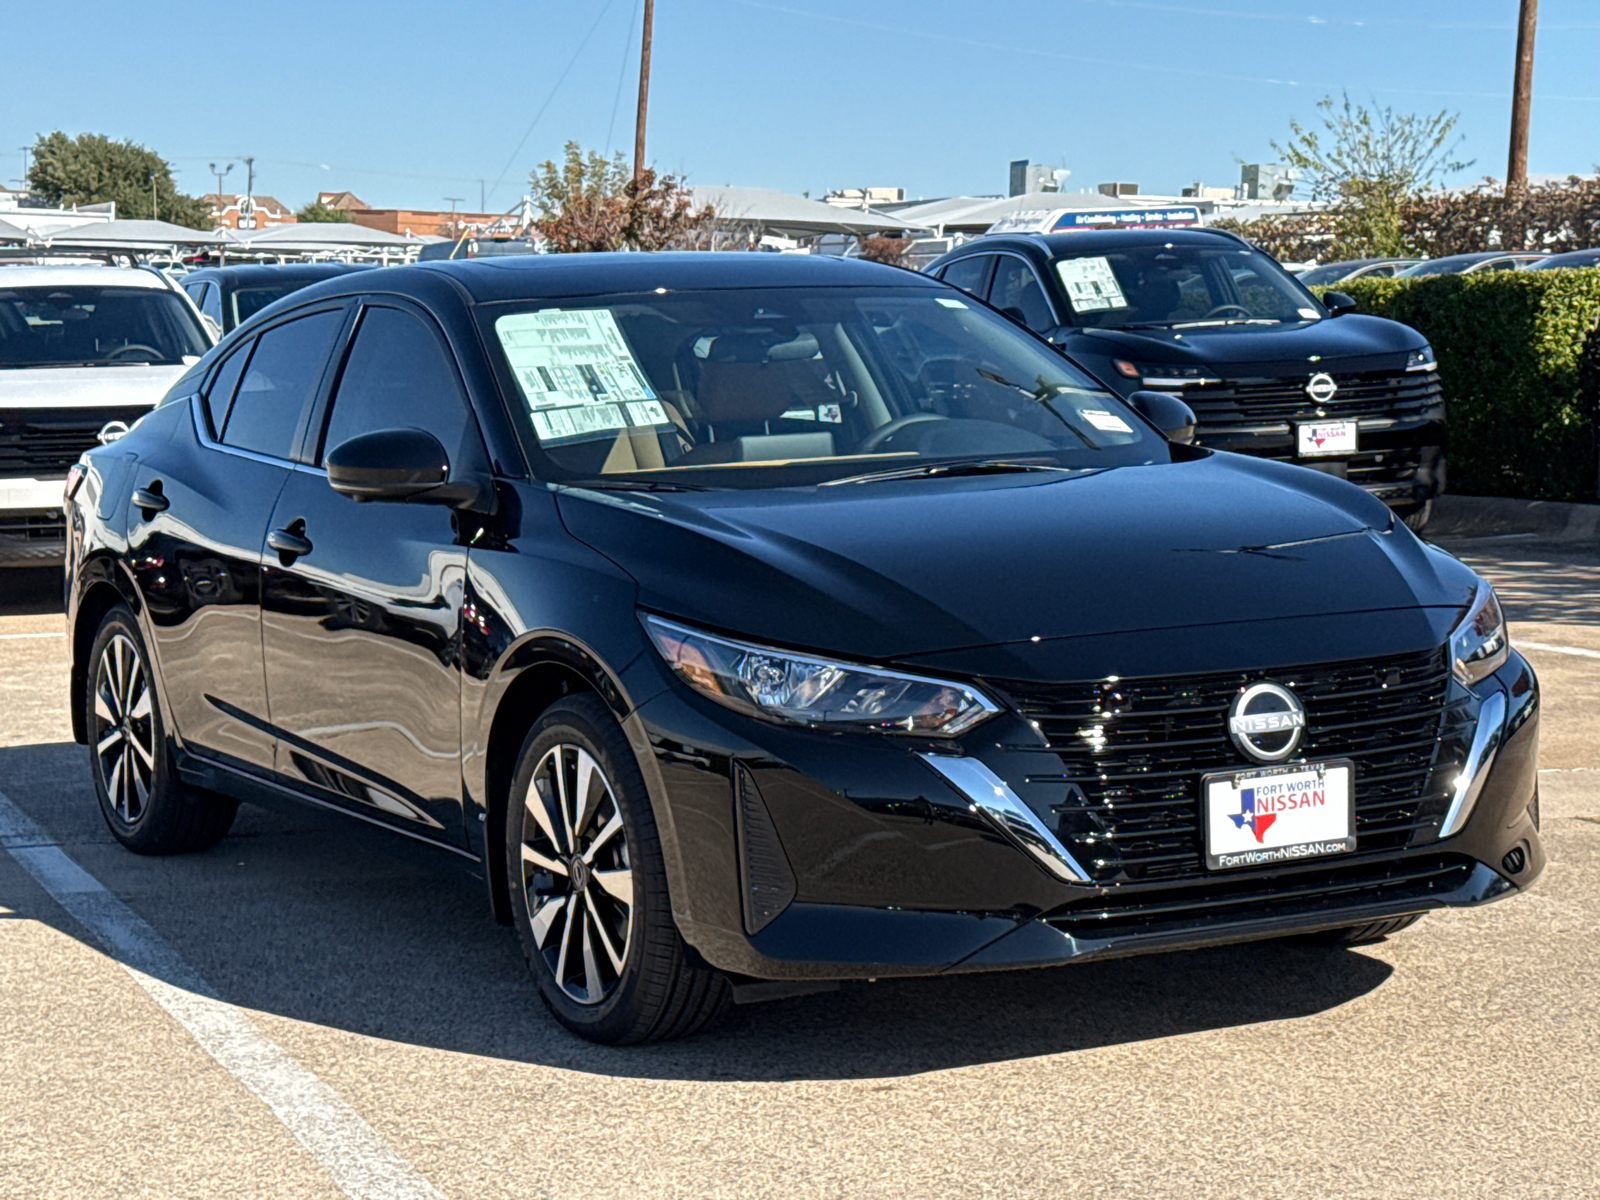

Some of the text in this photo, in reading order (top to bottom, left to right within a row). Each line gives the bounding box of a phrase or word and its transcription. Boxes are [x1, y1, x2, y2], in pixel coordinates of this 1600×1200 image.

[1233, 713, 1303, 732] NISSAN
[1235, 771, 1257, 780] FORT
[1260, 767, 1288, 777] WORTH
[1256, 779, 1325, 796] FORT WORTH
[1257, 789, 1325, 814] NISSAN
